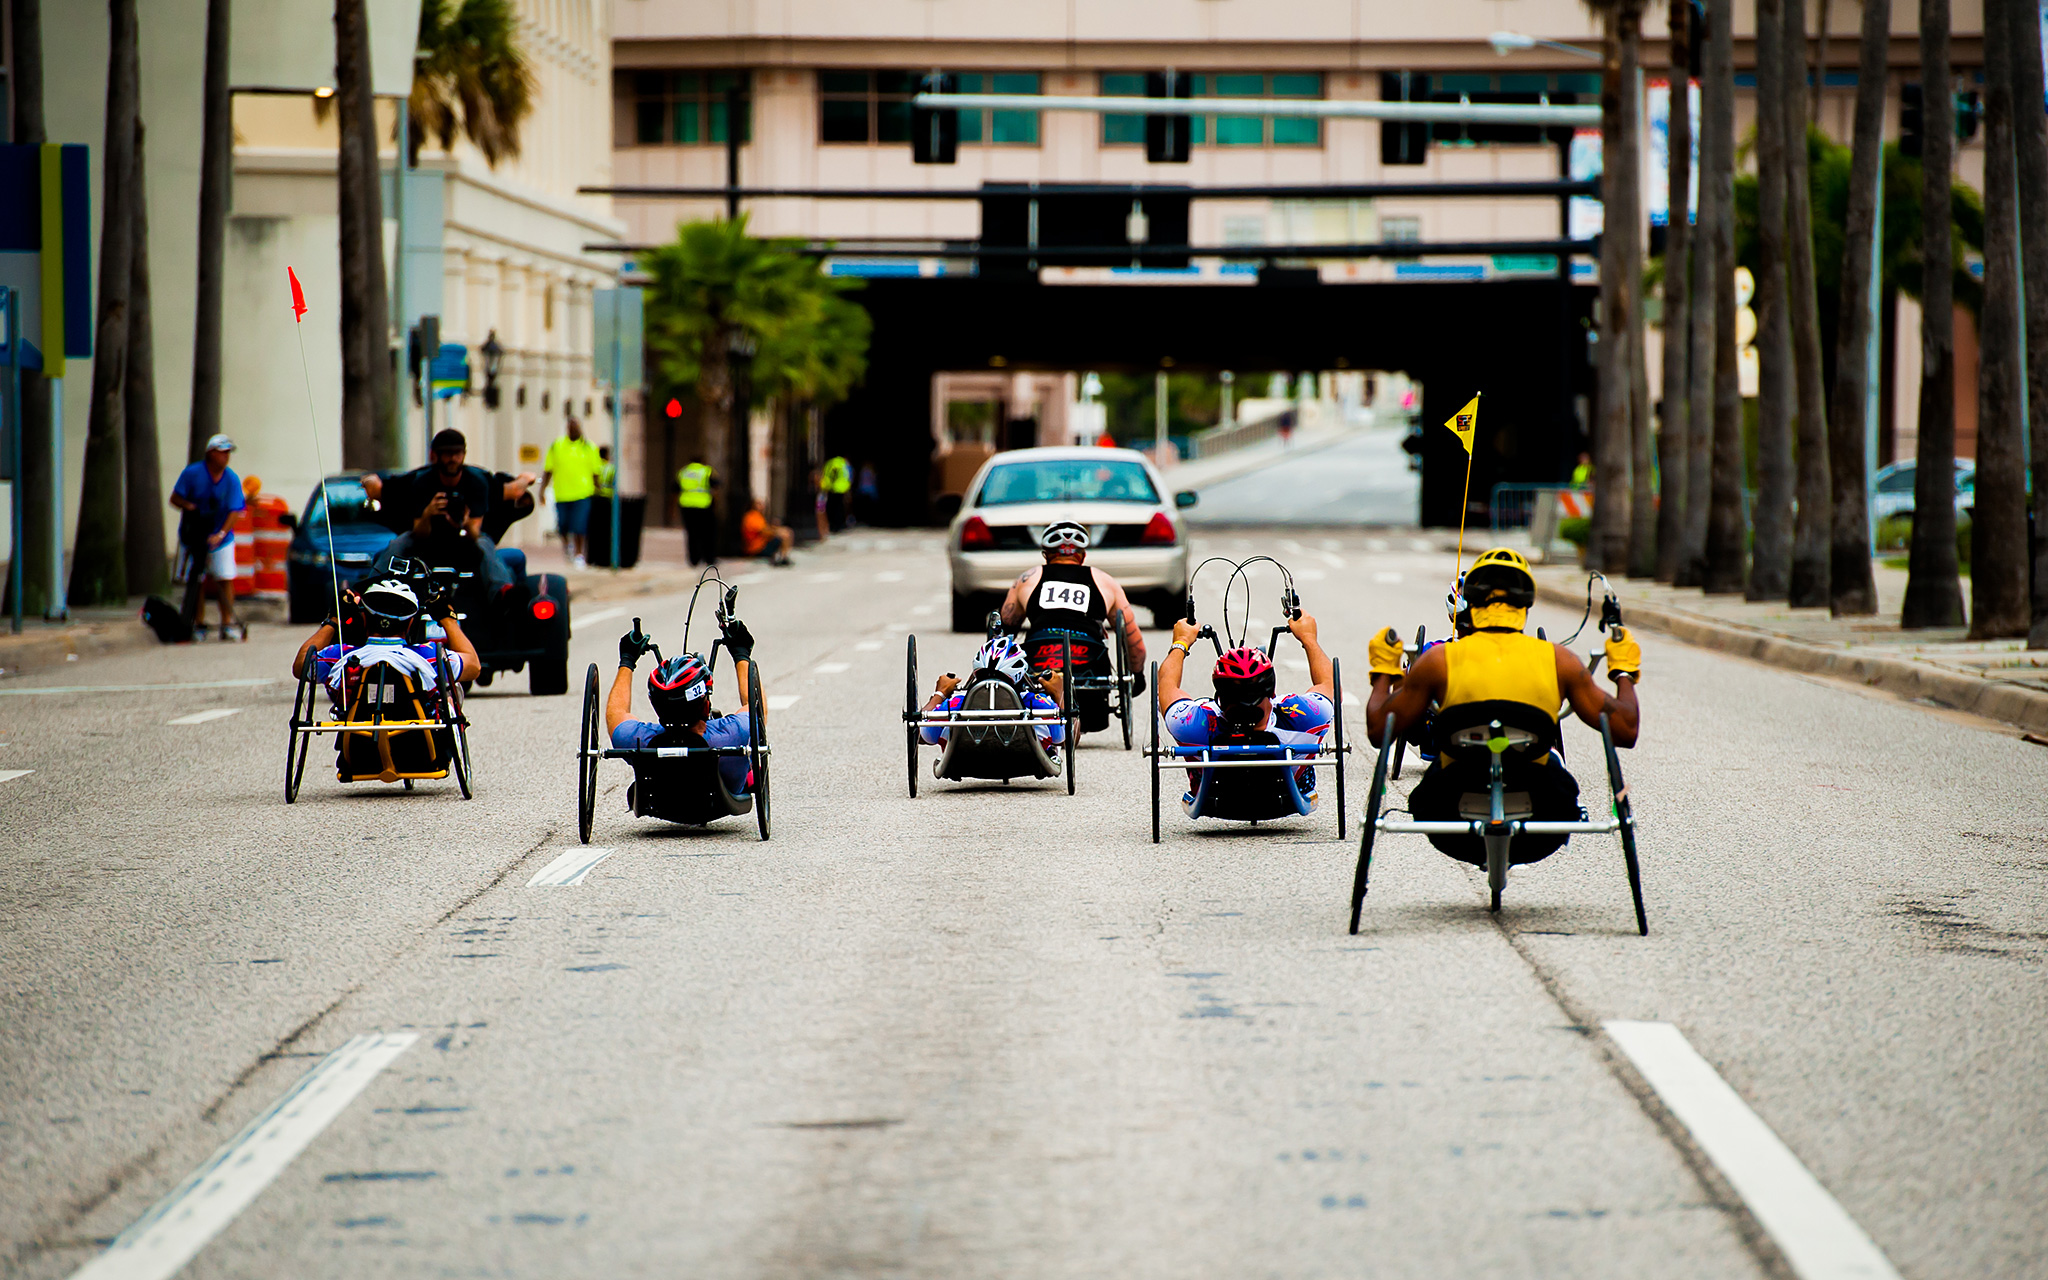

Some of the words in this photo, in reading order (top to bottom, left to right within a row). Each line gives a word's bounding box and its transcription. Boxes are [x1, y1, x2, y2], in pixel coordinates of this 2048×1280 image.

[1045, 587, 1086, 606] 148
[1037, 644, 1063, 656] TOP
[692, 685, 703, 698] 32
